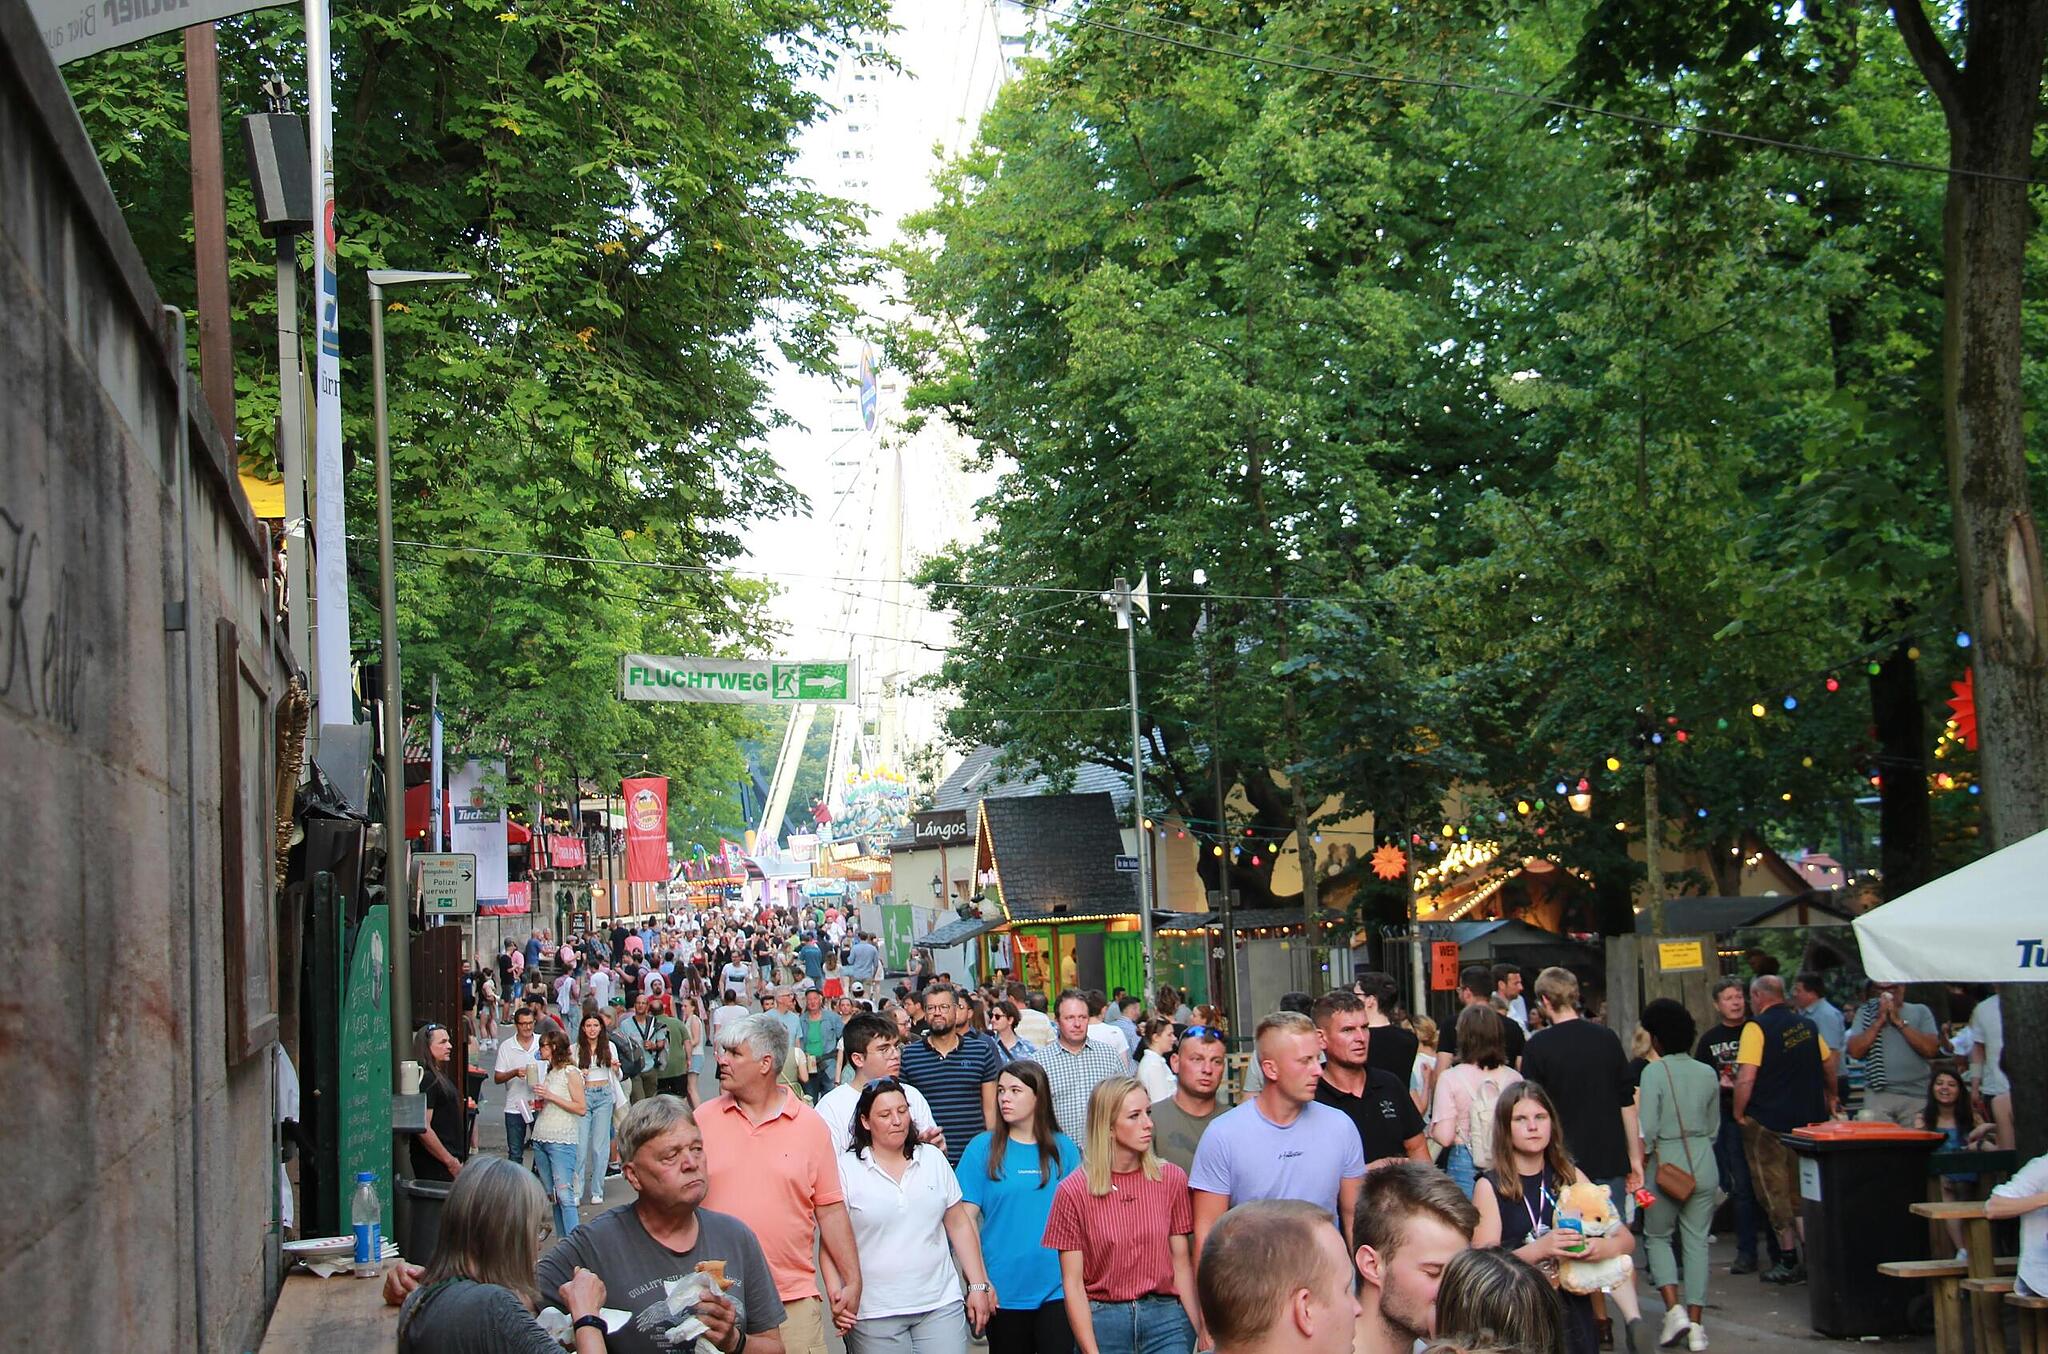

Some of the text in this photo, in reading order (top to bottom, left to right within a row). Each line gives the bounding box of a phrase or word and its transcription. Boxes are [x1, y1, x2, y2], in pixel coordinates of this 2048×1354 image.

[629, 667, 768, 692] FLUCHTWEG
[916, 820, 966, 840] Lángos
[1710, 1040, 1739, 1057] WAC
[628, 1278, 664, 1299] QUALITY
